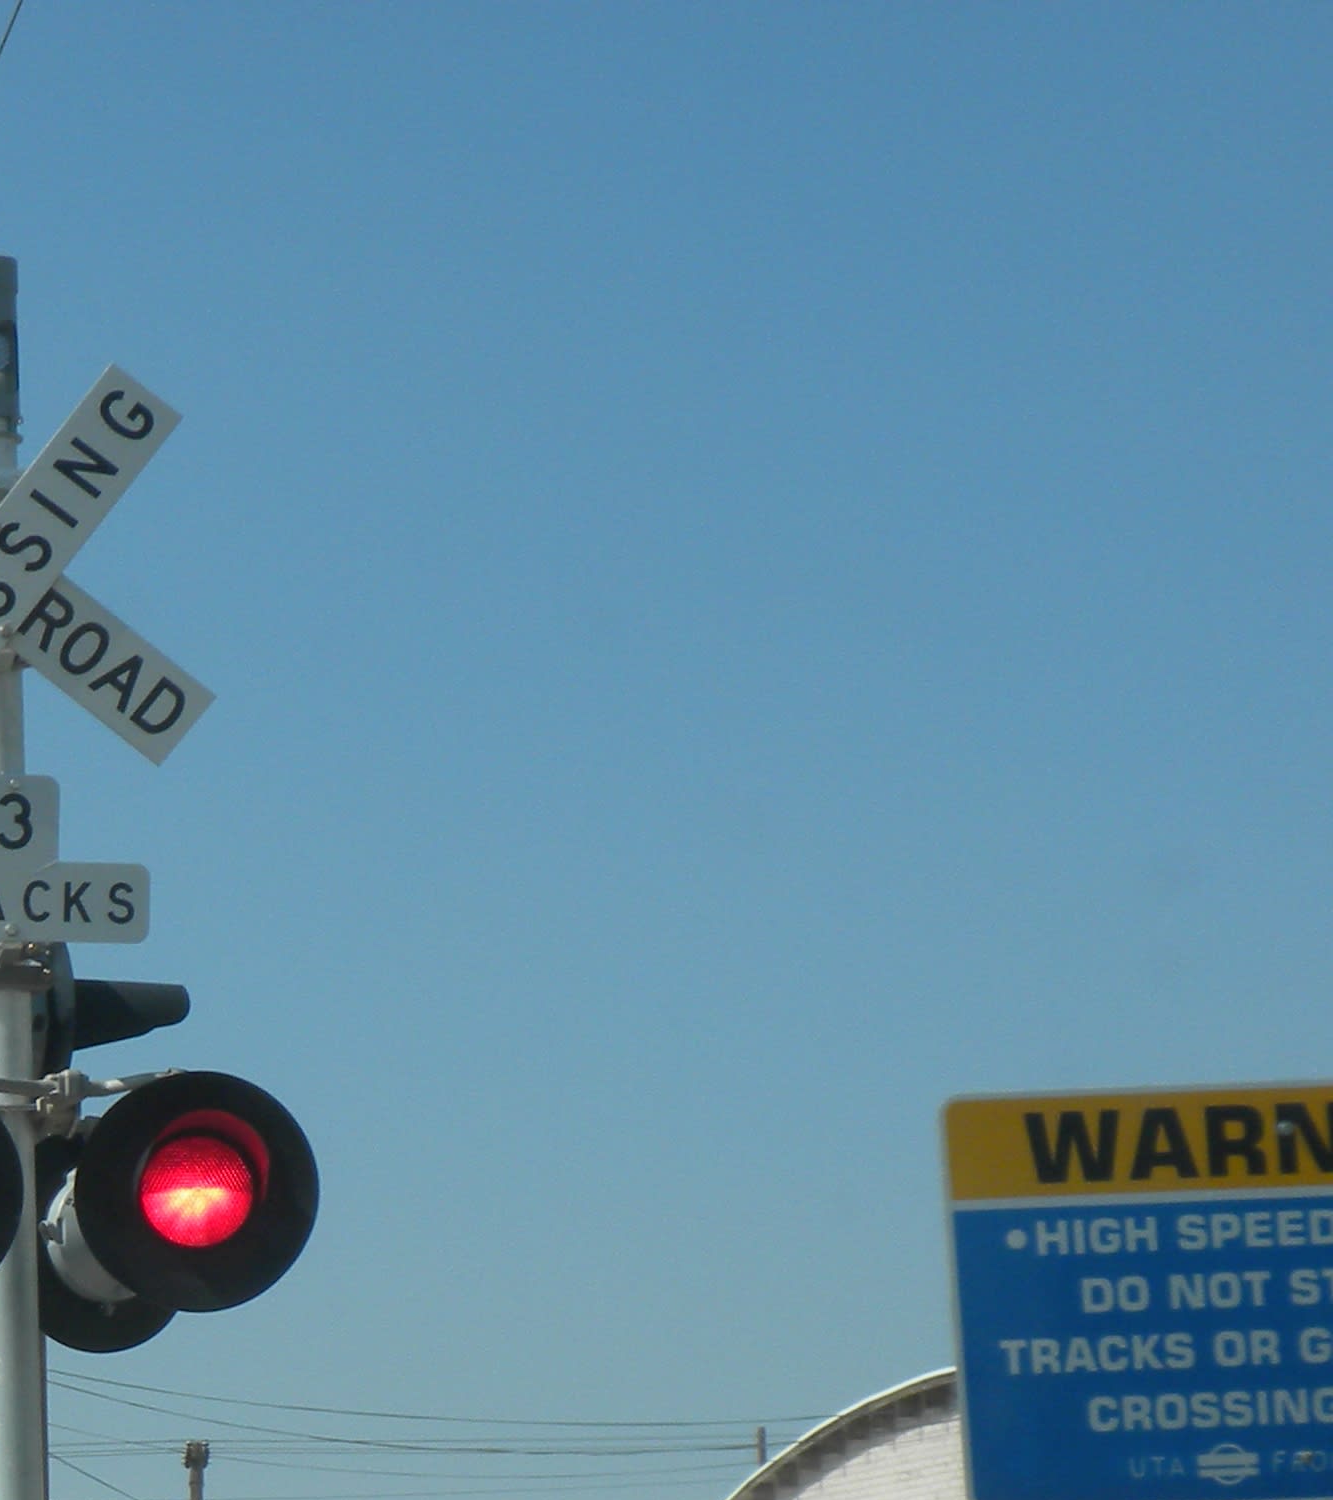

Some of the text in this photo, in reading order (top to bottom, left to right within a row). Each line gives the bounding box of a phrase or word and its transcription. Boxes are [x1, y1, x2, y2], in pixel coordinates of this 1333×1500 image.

[17, 587, 185, 735] ROAD
[1036, 1208, 1333, 1256] HIGH SPEED
[1081, 1275, 1150, 1314] DO
[1168, 1270, 1271, 1310] NOT
[999, 1331, 1196, 1376] TRACKS
[1213, 1329, 1281, 1368] OR
[1129, 1456, 1185, 1479] UTA
